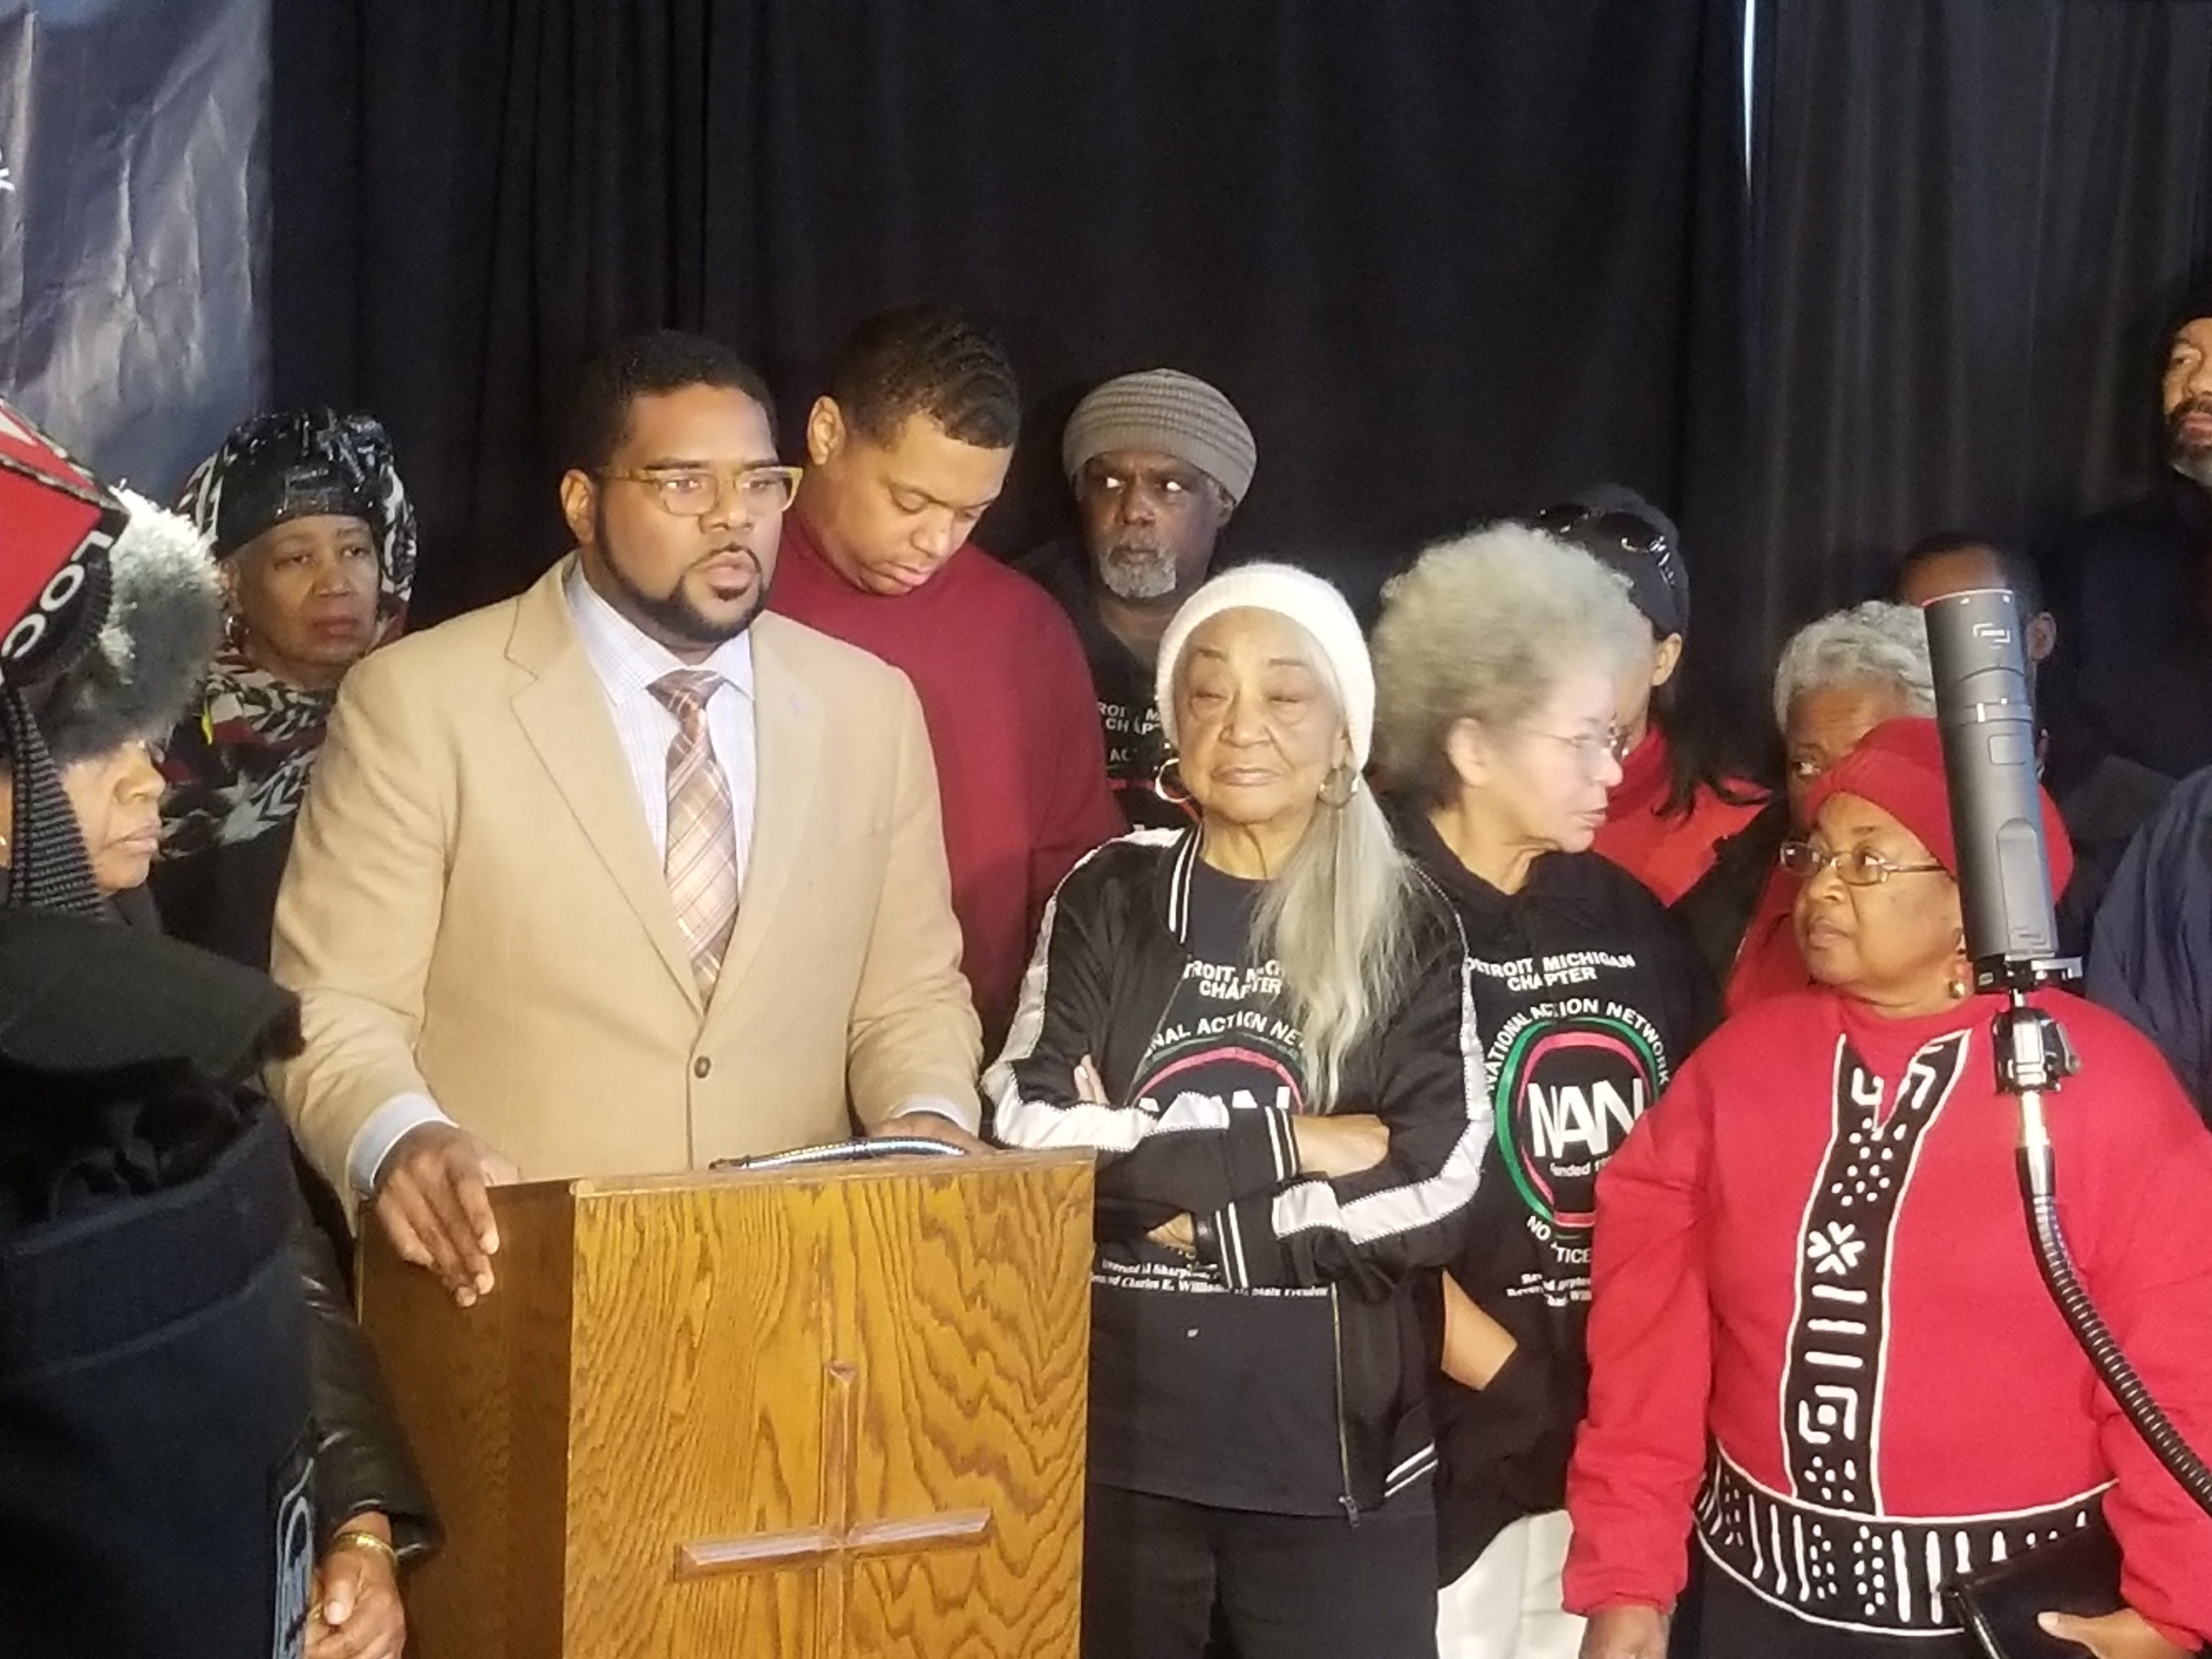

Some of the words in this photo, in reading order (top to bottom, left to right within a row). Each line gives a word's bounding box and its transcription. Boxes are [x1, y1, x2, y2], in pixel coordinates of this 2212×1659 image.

[0, 531, 114, 686] LOC
[1542, 952, 1635, 972] MICHIGAN
[1507, 967, 1598, 991] CHAPTER
[1270, 1019, 1304, 1049] NE
[1606, 1002, 1670, 1085] NETWORK
[1527, 1077, 1644, 1159] NAN
[1527, 1215, 1551, 1241] NO
[1550, 1241, 1592, 1263] TICE
